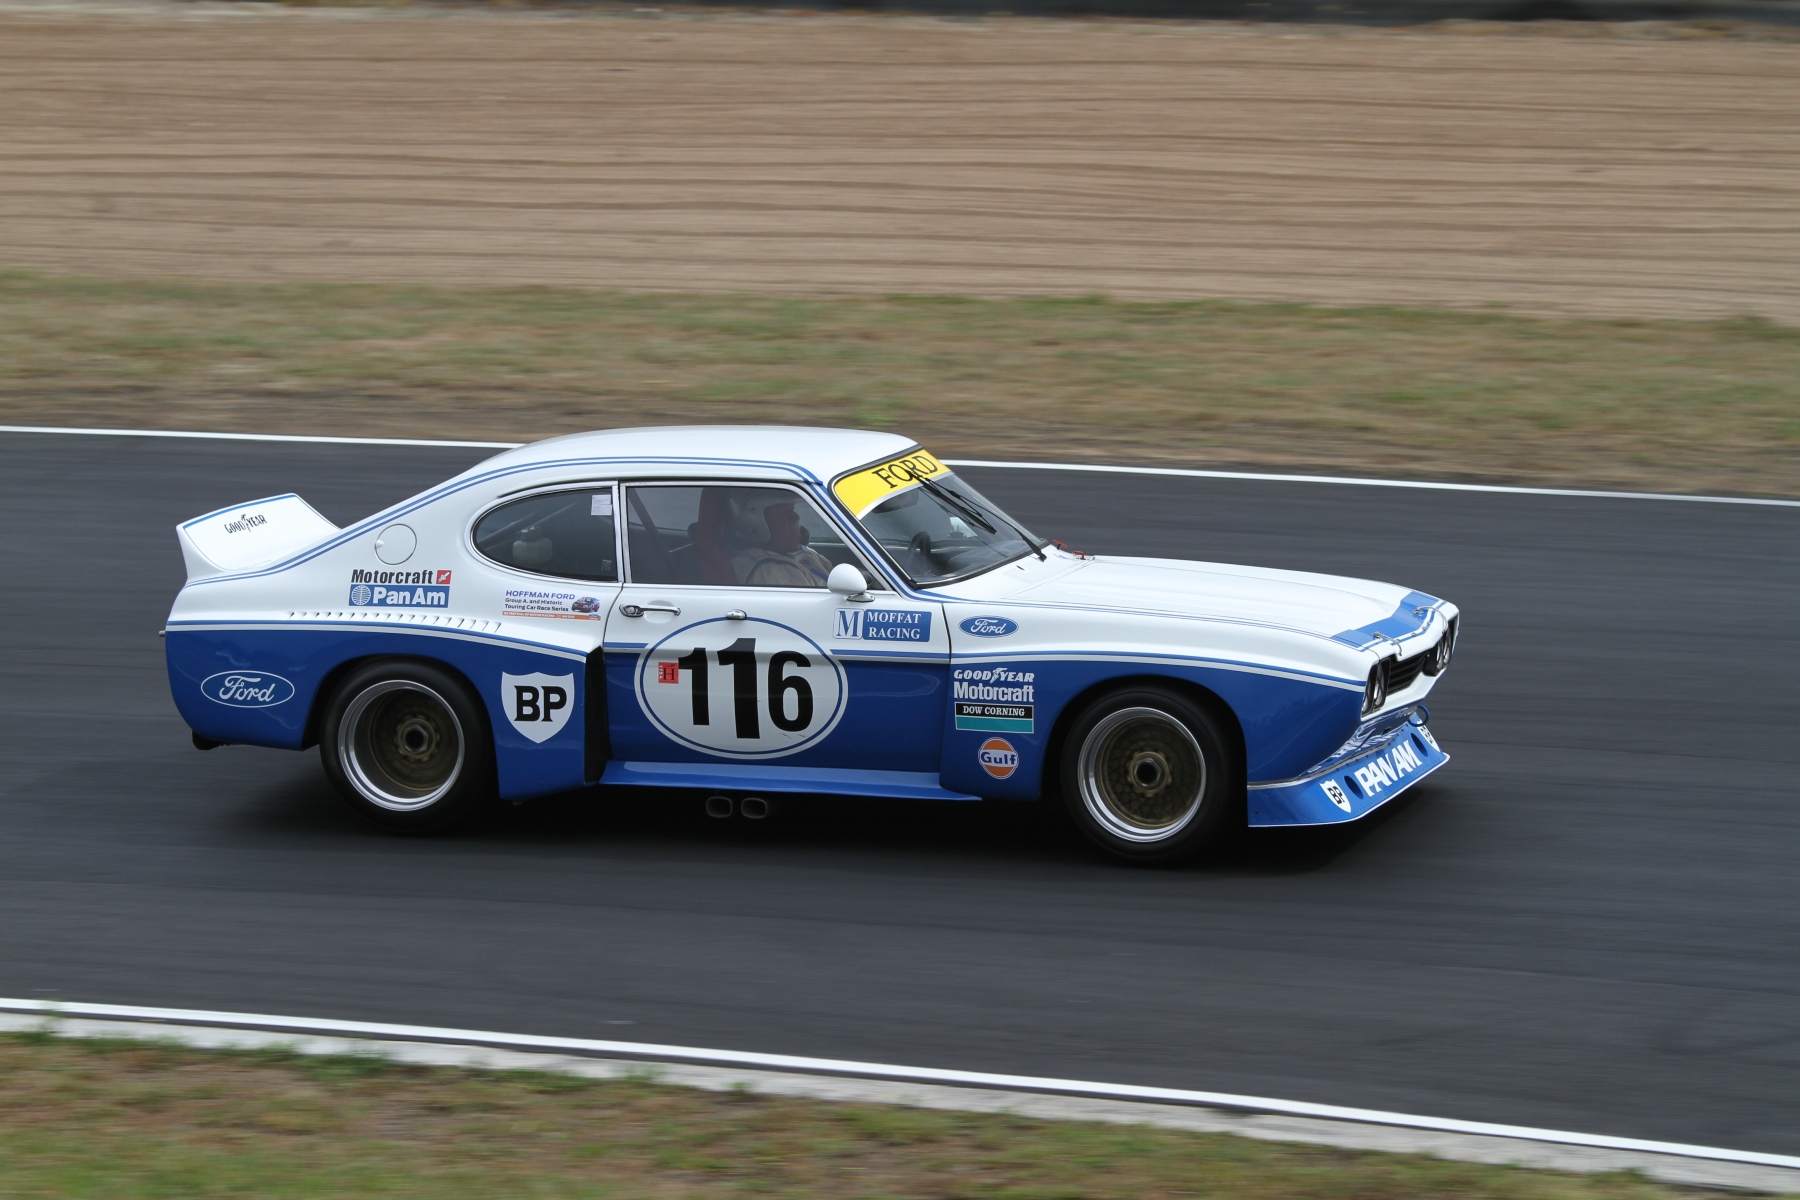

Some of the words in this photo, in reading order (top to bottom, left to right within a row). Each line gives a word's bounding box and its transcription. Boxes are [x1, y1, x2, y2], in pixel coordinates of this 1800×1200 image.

[872, 456, 938, 488] FORD
[351, 569, 433, 584] Motorcraft
[506, 590, 550, 598] HOFFMAN
[836, 610, 861, 637] M
[867, 612, 922, 624] MOFFAT
[970, 618, 1007, 634] Ford
[868, 626, 920, 640] RACING
[954, 668, 1034, 684] GOODYEAR
[219, 676, 276, 702] Ford
[678, 638, 813, 739] 116
[954, 681, 1034, 702] Motorcraft
[514, 686, 567, 722] BP
[963, 706, 982, 714] DOW
[985, 707, 1025, 716] CORNING
[981, 752, 1016, 764] Gulf
[1354, 754, 1398, 797] PAN
[1392, 740, 1422, 778] AM
[1327, 786, 1345, 804] BP
